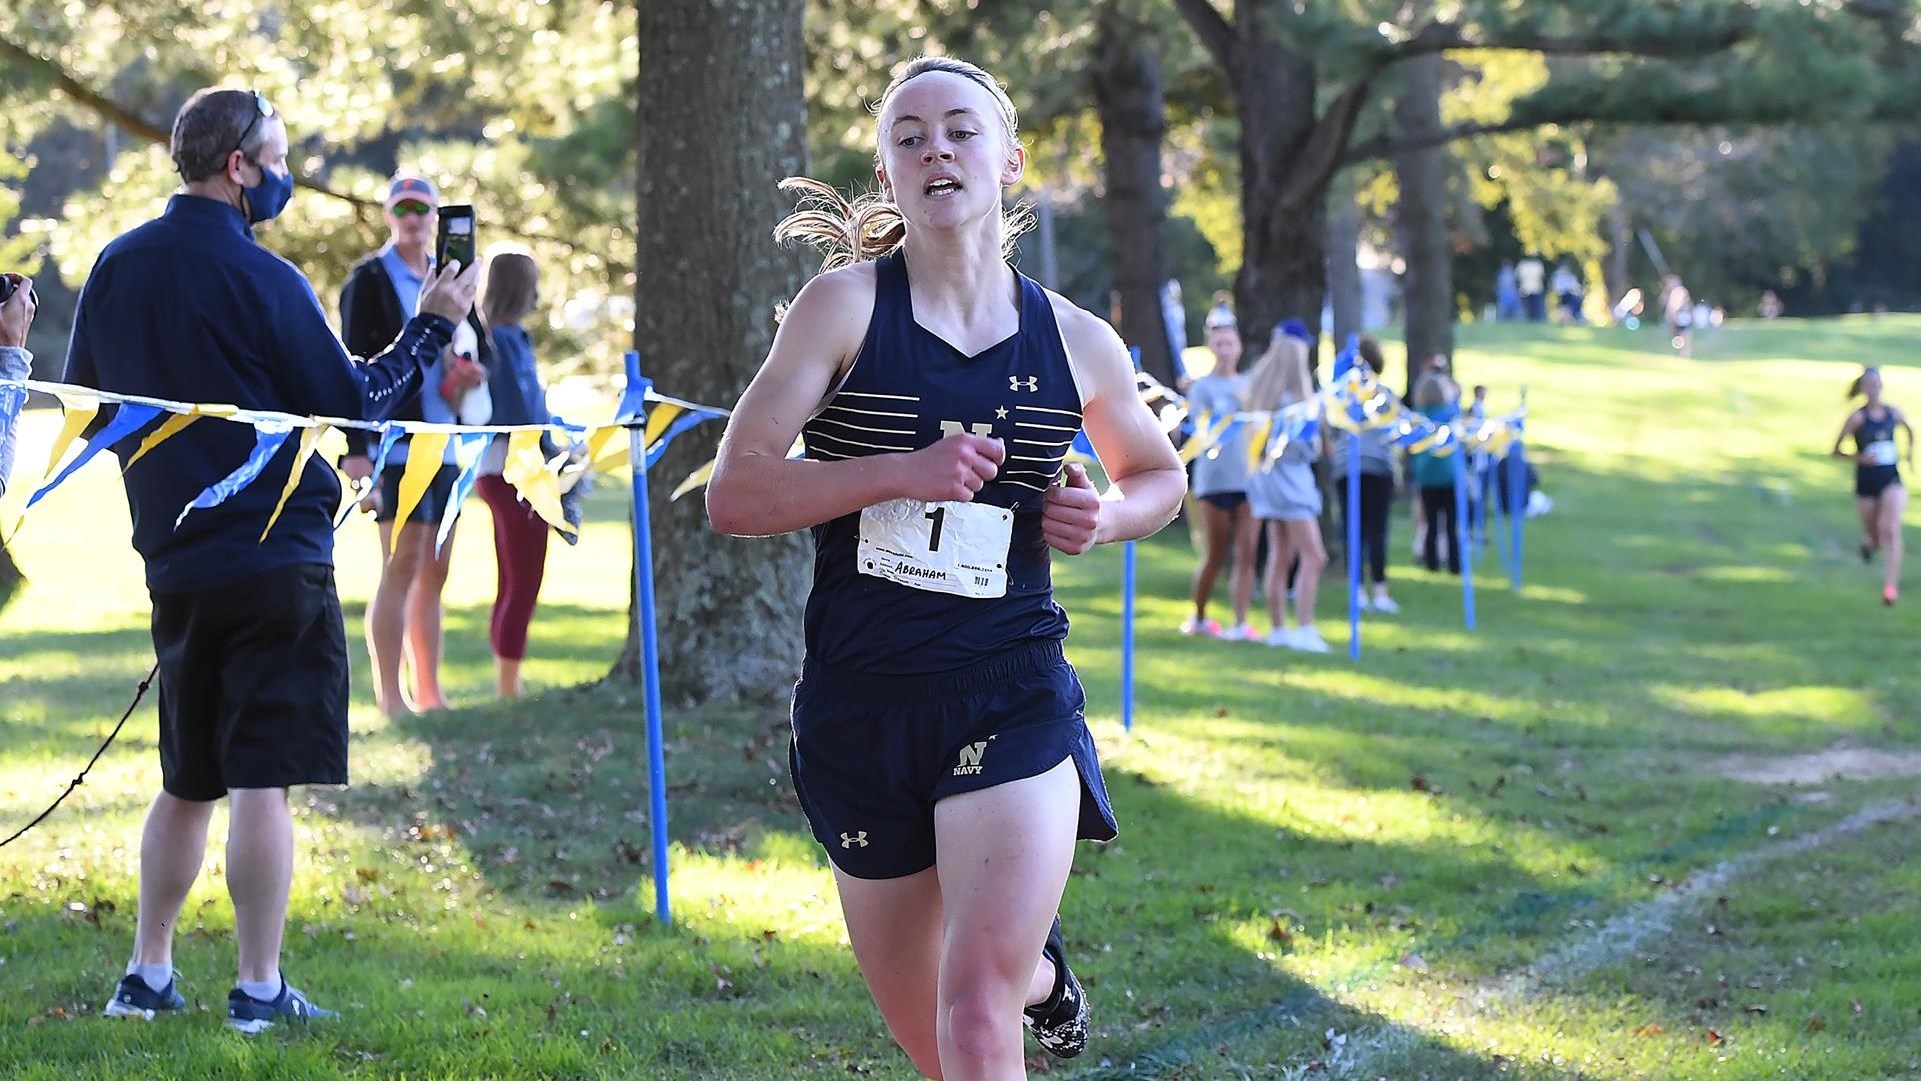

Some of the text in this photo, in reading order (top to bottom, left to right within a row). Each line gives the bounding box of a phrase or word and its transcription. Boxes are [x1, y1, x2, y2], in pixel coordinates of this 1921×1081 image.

[924, 506, 945, 553] 1
[894, 561, 946, 581] ABRAHAM
[956, 741, 987, 767] N
[953, 766, 983, 776] NAVY
